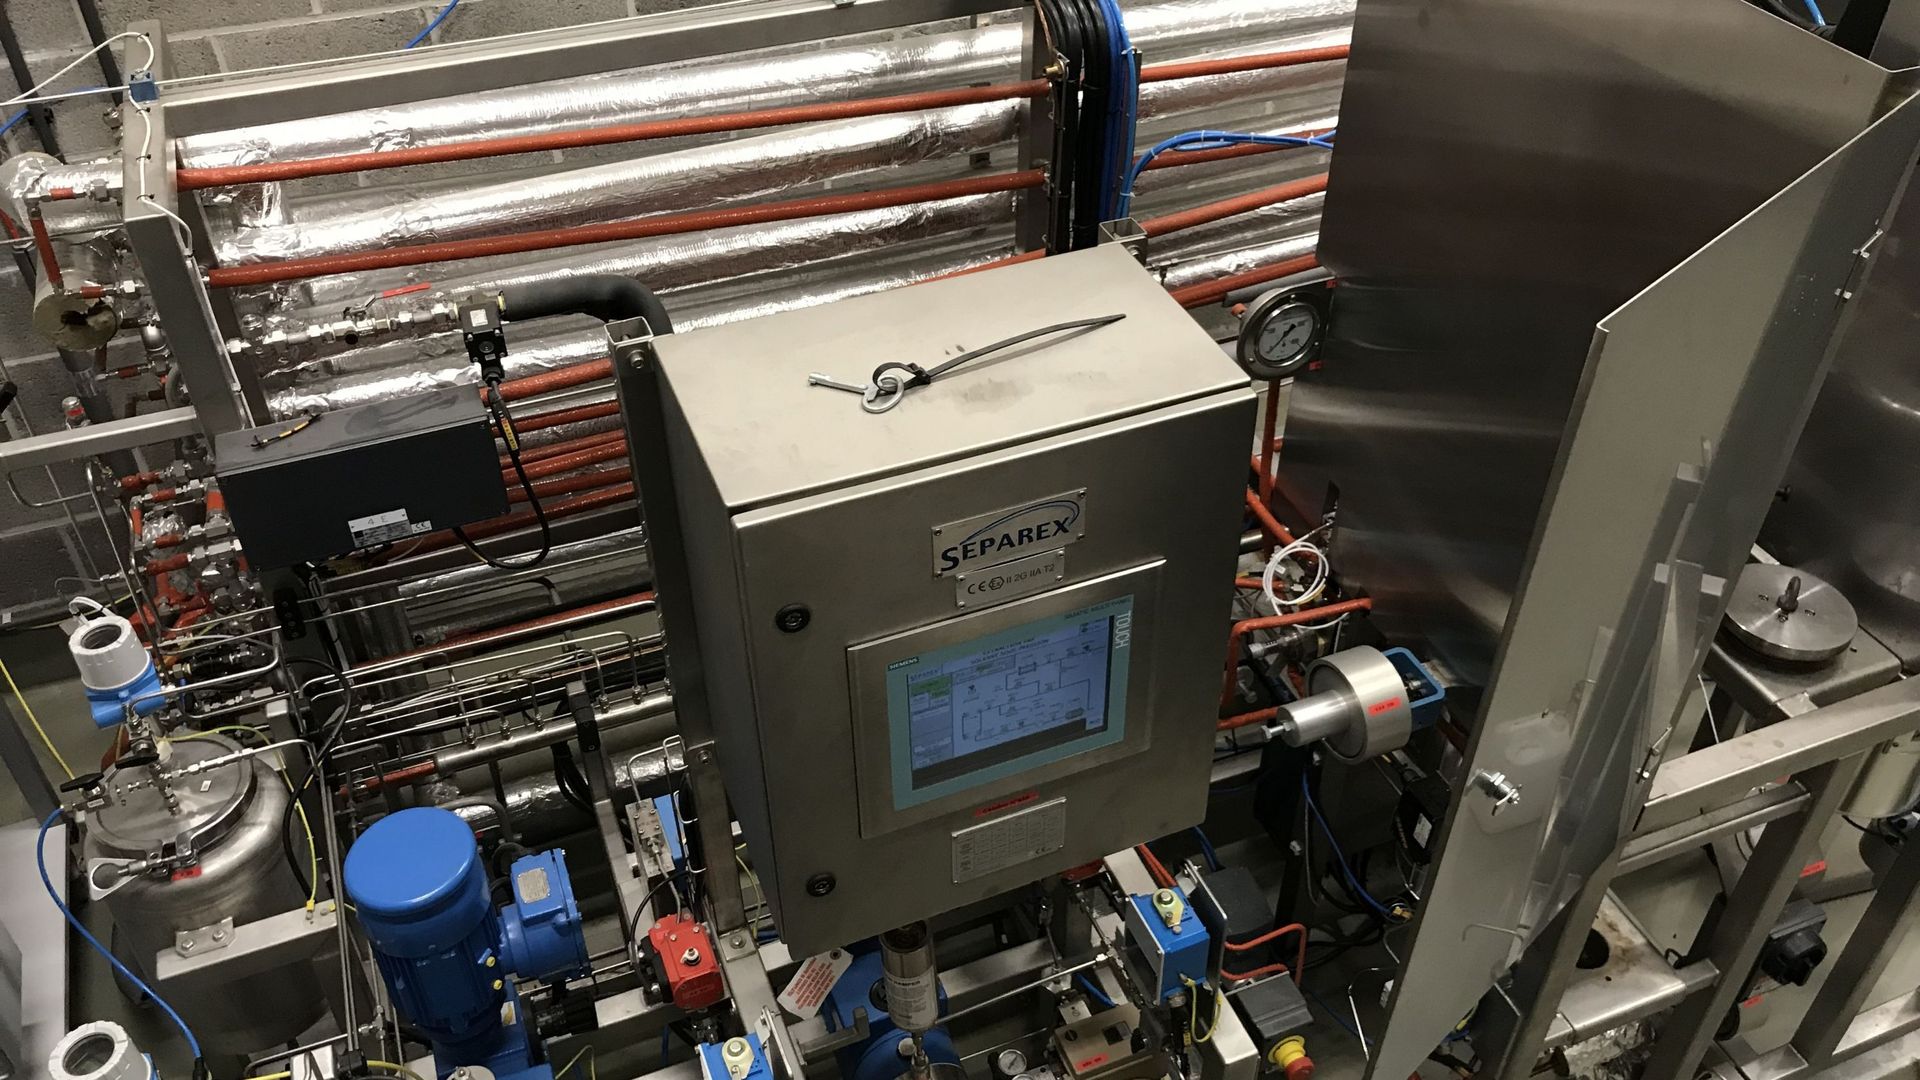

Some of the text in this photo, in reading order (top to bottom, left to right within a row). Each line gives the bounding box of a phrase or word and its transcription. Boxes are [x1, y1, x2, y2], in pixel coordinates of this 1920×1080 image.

[941, 516, 1070, 572] SEPAREX
[1014, 571, 1028, 582] 2G
[1044, 563, 1056, 573] T2
[1115, 610, 1132, 649] TOUCH
[889, 658, 918, 669] SIEMENS
